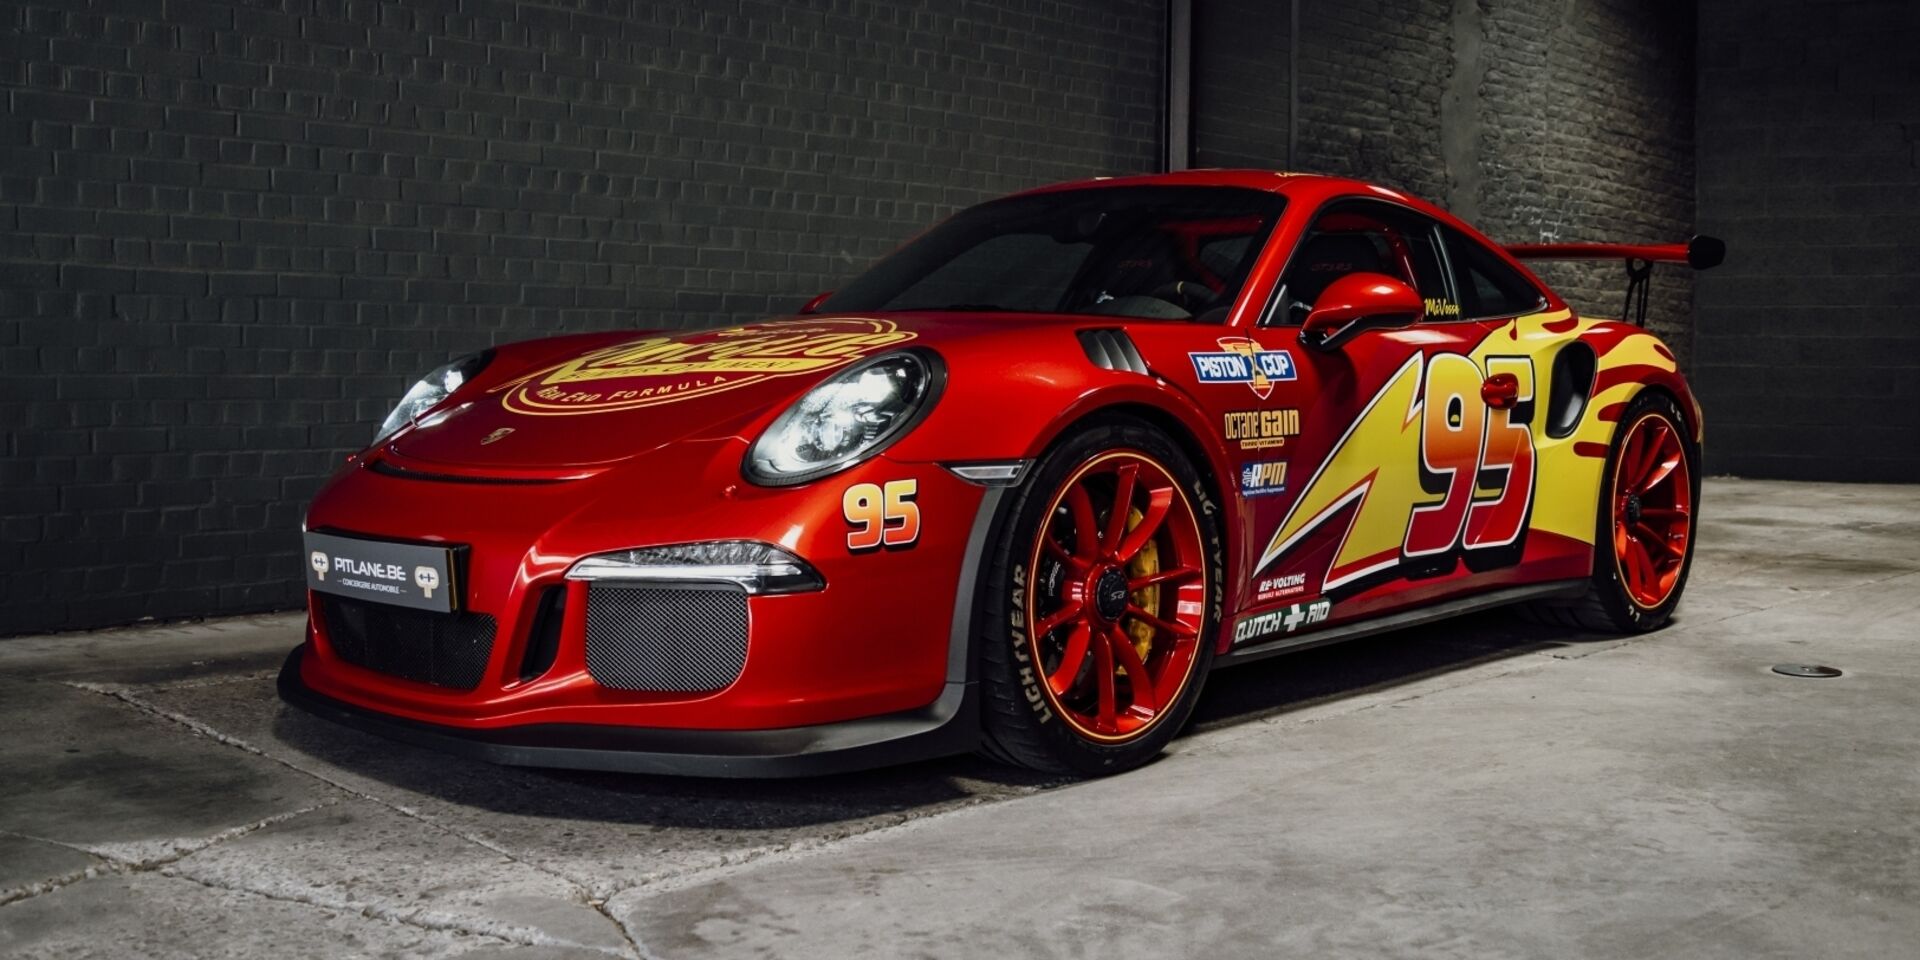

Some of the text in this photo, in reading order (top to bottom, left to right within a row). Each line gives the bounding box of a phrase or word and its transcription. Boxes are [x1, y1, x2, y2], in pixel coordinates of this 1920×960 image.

[1196, 354, 1290, 378] PISTON CUP
[605, 375, 727, 401] FORMULA
[1402, 351, 1537, 560] 95
[1249, 461, 1288, 488] RPM
[842, 478, 921, 551] 95
[334, 557, 407, 581] PITLANE.BE
[1234, 601, 1331, 644] CLUTCH AID
